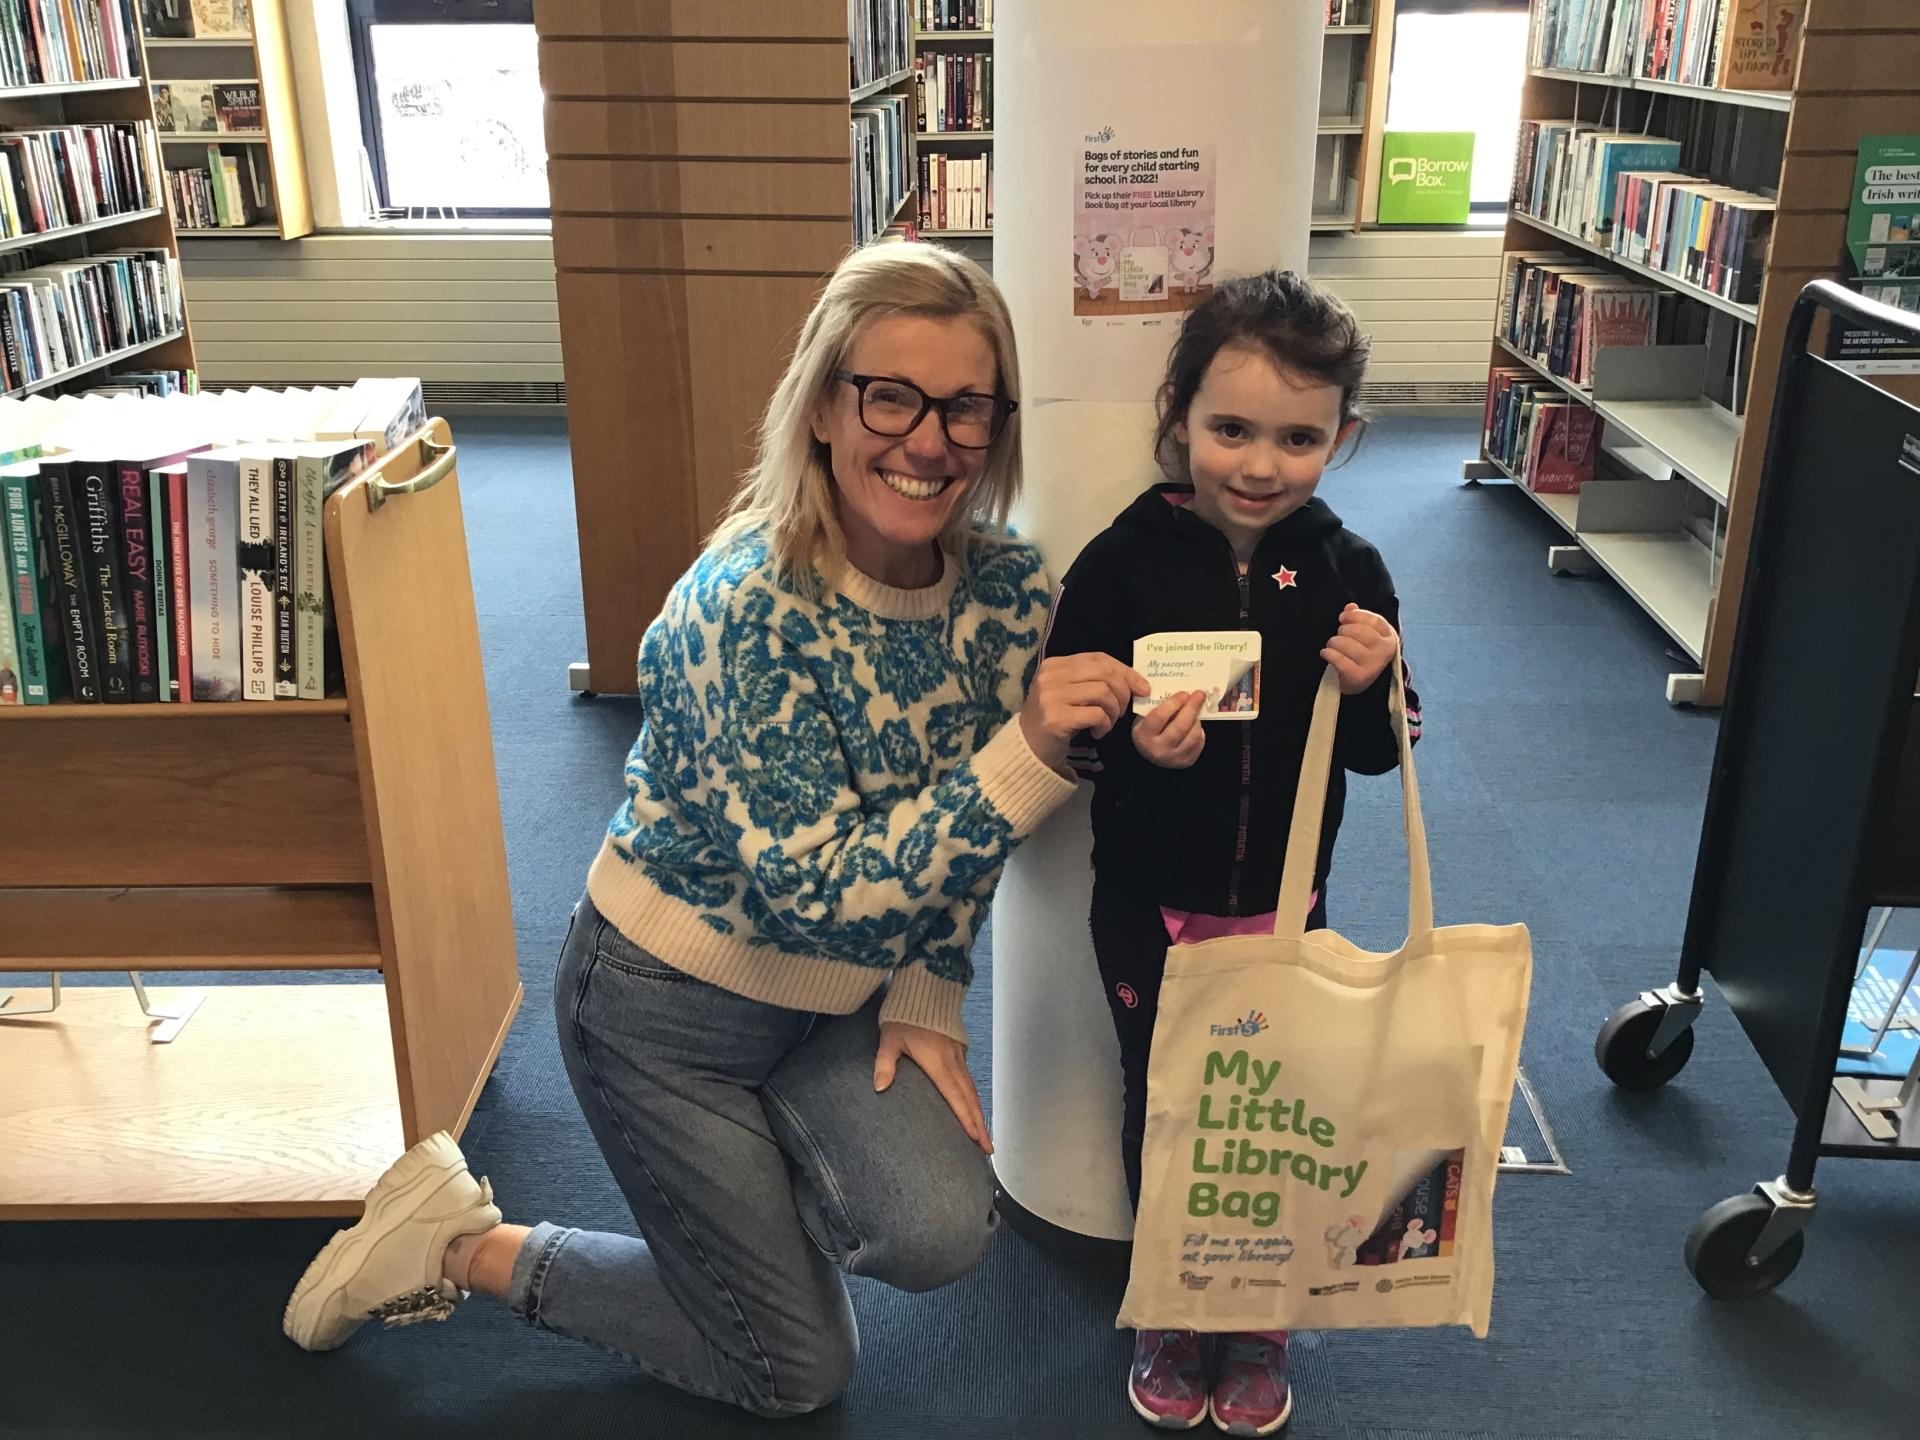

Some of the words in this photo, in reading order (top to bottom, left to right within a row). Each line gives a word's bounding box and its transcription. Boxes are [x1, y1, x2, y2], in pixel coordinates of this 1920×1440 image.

[222, 89, 257, 99] WILBUR
[227, 96, 256, 106] SMITH
[1084, 150, 1108, 162] Bags
[1110, 150, 1121, 160] of
[1123, 150, 1158, 160] stories
[1160, 148, 1179, 159] and
[1181, 148, 1199, 158] fun
[1417, 157, 1469, 172] Borrow
[1084, 163, 1099, 173] for
[1101, 164, 1129, 174] every
[1131, 161, 1157, 172] child
[1158, 160, 1200, 171] starting
[1870, 169, 1893, 181] The
[1084, 175, 1117, 185] school
[1118, 174, 1128, 184] in
[1130, 174, 1159, 184] 2022!
[1415, 172, 1446, 187] Box.
[1084, 191, 1101, 200] Pick
[1101, 192, 1112, 201] up
[1113, 191, 1132, 199] their
[1133, 190, 1153, 198] FREE
[1154, 190, 1176, 198] Little
[1177, 189, 1205, 198] Library
[1084, 201, 1103, 209] Book
[1104, 201, 1119, 210] Bag
[1130, 201, 1148, 210] your
[1866, 188, 1894, 200] Irish
[49, 477, 60, 503] BRIAN
[206, 469, 218, 515] elizabeth
[248, 467, 259, 494] THEY
[7, 486, 24, 510] FOUR
[120, 470, 143, 523] REAL
[249, 495, 259, 515] ALL
[278, 480, 287, 513] DEATH
[86, 475, 109, 554] Griffiths
[10, 512, 28, 553] AUNTIES
[172, 521, 180, 535] THE
[204, 516, 216, 550] george
[249, 516, 260, 539] LIED
[53, 505, 77, 588] McGILLOWAY
[125, 528, 147, 581] EASY
[172, 536, 181, 554] NINE
[279, 526, 288, 573] IRELAND'S
[16, 555, 28, 570] AND
[155, 559, 164, 587] DONNA
[174, 555, 182, 575] LIVES
[100, 565, 111, 588] The
[175, 576, 183, 587] OF
[279, 575, 288, 591] EYE
[69, 594, 77, 606] THE
[176, 588, 184, 609] ROSE
[208, 559, 219, 618] SOMETHING
[102, 590, 117, 630] Locked
[133, 588, 146, 622] MARIE
[250, 582, 262, 621] LOUISE
[70, 609, 84, 643] EMPTY
[211, 621, 220, 634] TO
[280, 611, 289, 629] DEAN
[176, 609, 186, 657] NAPOLITANO
[106, 633, 118, 664] Room
[212, 638, 221, 661] HIDE
[251, 625, 264, 674] PHILLIPS
[1146, 643, 1163, 652] I've
[1165, 643, 1194, 654] joined
[1195, 643, 1211, 651] the
[1213, 641, 1248, 653] library!
[76, 645, 90, 678] ROOM
[1146, 659, 1160, 669] My
[1161, 660, 1194, 669] passport
[1209, 1023, 1240, 1037] First
[1203, 1050, 1282, 1096] My
[1197, 1094, 1336, 1148] Little
[1192, 1138, 1368, 1199] Library
[1446, 1165, 1460, 1198] CATS
[1187, 1182, 1281, 1227] Bag
[1183, 1233, 1208, 1247] Fill
[1210, 1238, 1229, 1247] me
[1235, 1238, 1250, 1250] up
[1182, 1251, 1200, 1261] at
[1201, 1253, 1234, 1266] your
[1238, 1248, 1295, 1266] library!
